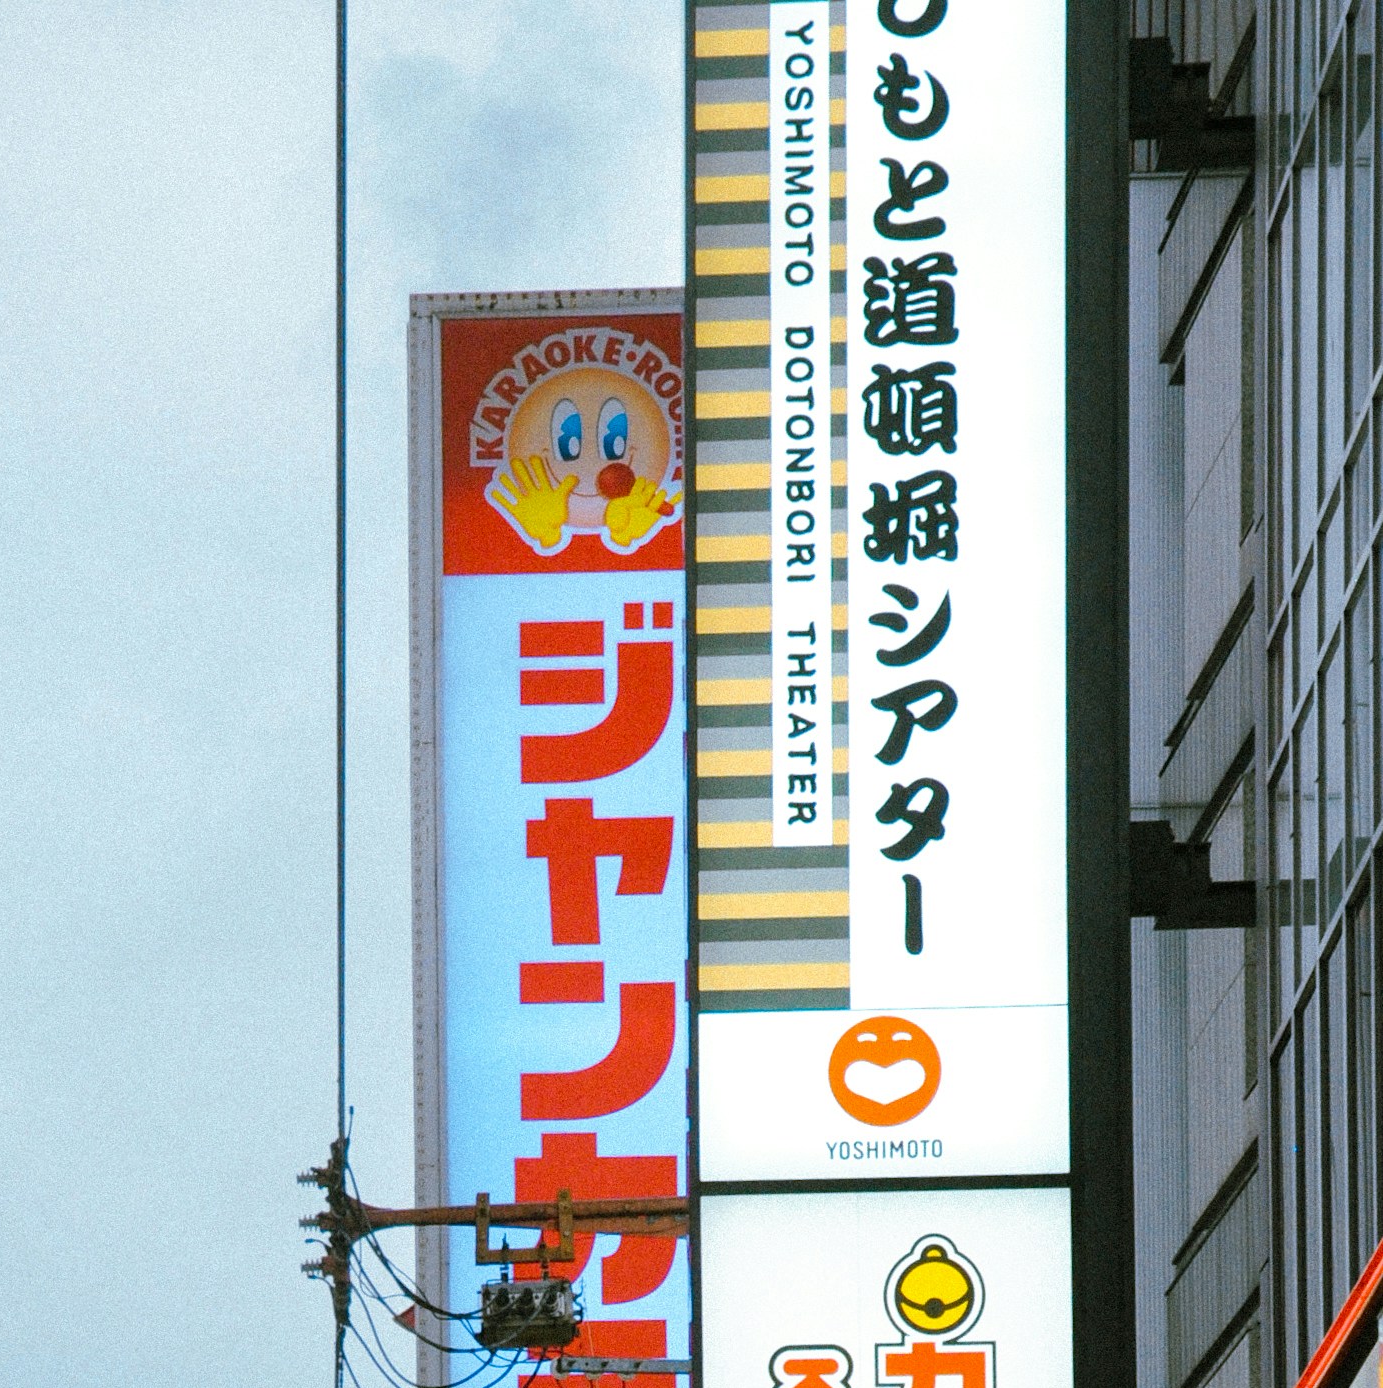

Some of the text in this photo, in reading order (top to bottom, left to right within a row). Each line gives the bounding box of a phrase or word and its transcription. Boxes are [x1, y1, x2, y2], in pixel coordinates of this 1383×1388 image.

[783, 20, 818, 827] YOSHIMOTO DOTONBORI THEATER
[825, 1138, 944, 1161] YOSHIMOTO
